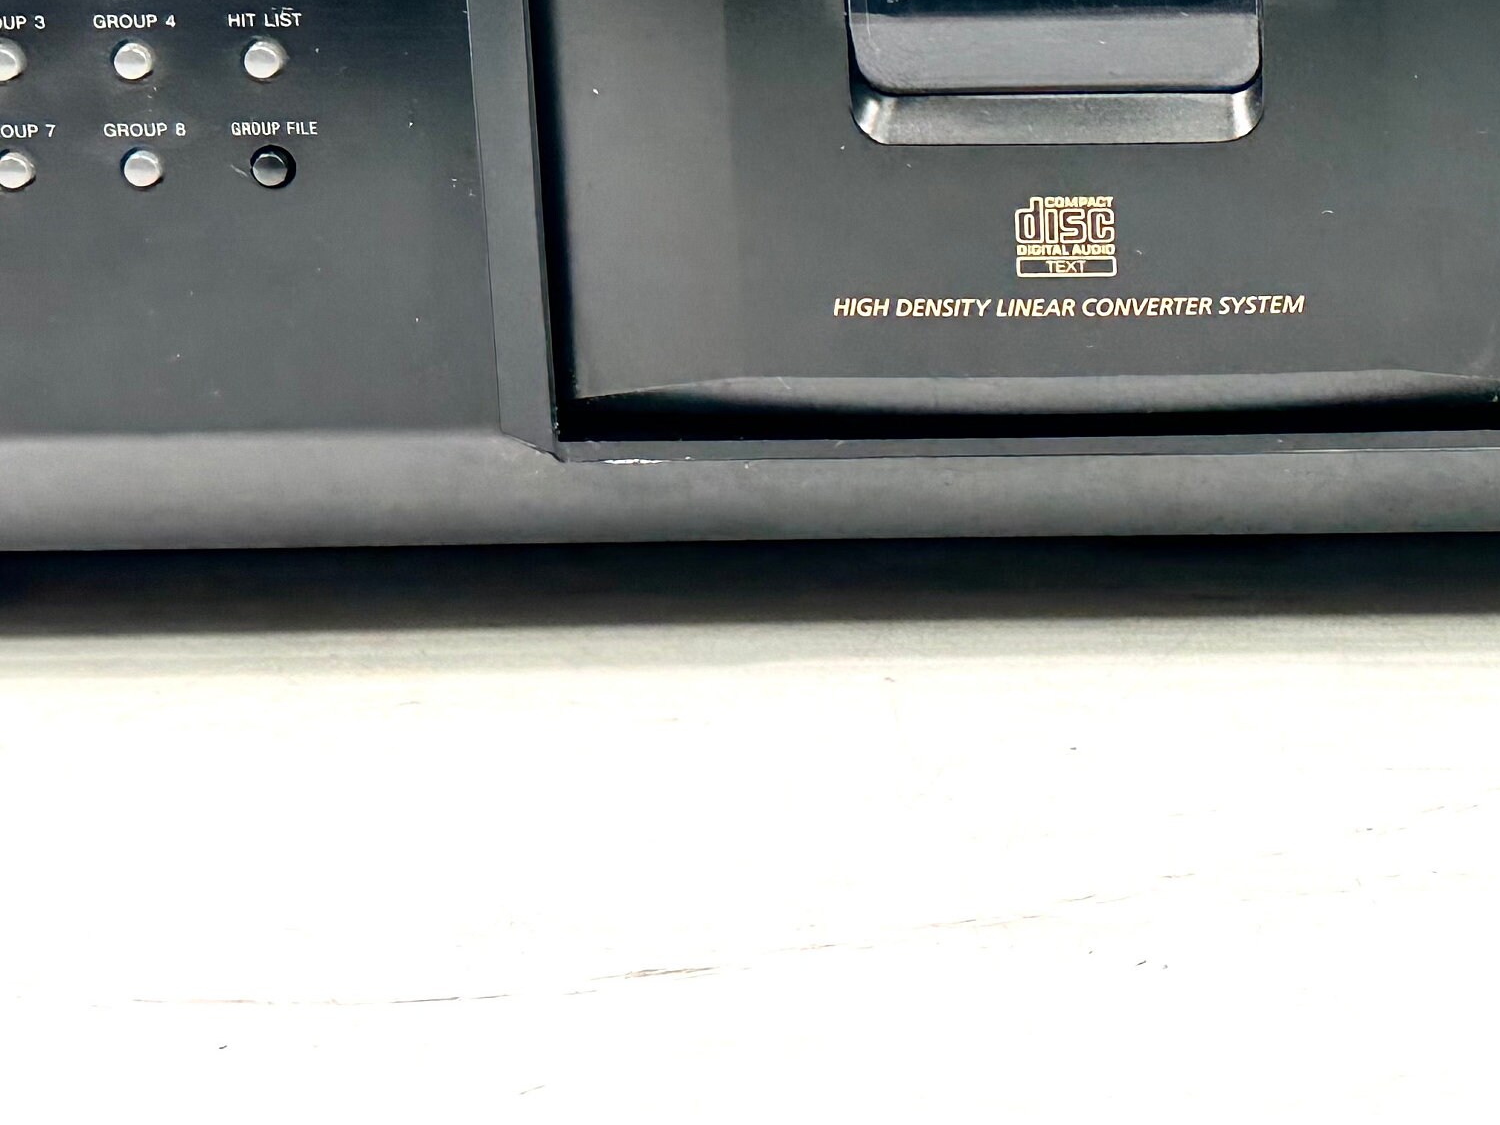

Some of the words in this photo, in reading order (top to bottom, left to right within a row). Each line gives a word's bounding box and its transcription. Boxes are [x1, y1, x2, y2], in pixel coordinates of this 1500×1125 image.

[0, 14, 27, 30] UP
[34, 14, 46, 30] 3
[93, 15, 158, 30] GROUP
[165, 14, 176, 28] 4
[227, 13, 256, 27] HIT
[264, 12, 302, 27] LIST
[45, 123, 56, 138] 7
[103, 123, 168, 138] GROUP
[175, 122, 187, 137] 8
[230, 122, 281, 136] GROUP
[287, 121, 319, 136] FILE
[1044, 196, 1114, 208] COMPACT
[1016, 244, 1070, 256] DIGITAL
[1072, 244, 1116, 255] AUDIO
[1045, 260, 1086, 273] TEXT
[833, 297, 891, 317] HIGH
[895, 297, 992, 318] DENSITY
[996, 297, 1076, 317] LINEAR
[1081, 296, 1213, 317] CONVERTER
[1218, 295, 1306, 315] SYSTEM
